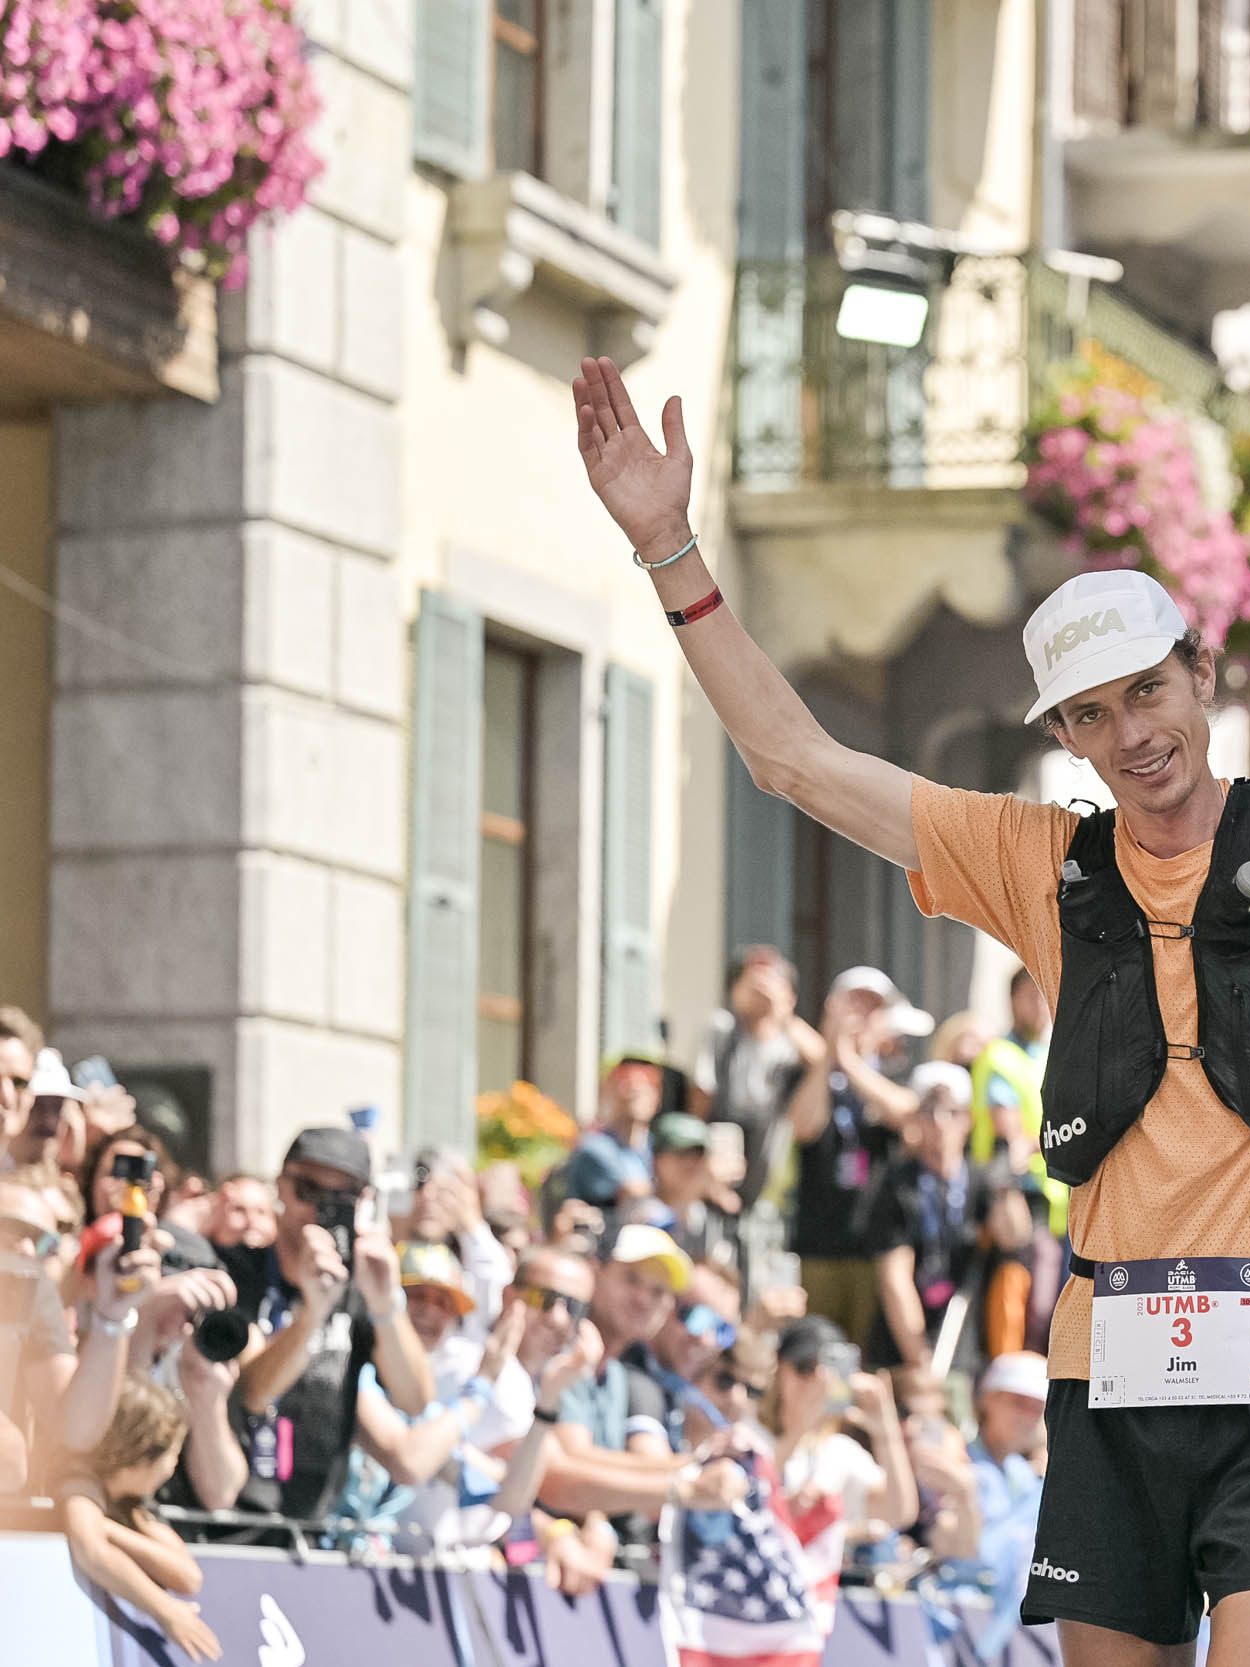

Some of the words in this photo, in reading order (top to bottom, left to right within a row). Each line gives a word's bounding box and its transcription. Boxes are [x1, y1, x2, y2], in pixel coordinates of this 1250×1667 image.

[1043, 607, 1126, 671] HOKA
[1167, 1275, 1196, 1285] UTMB
[1136, 1296, 1144, 1317] 2023
[1170, 1317, 1193, 1348] 3
[1166, 1356, 1197, 1372] Jim
[1164, 1377, 1200, 1385] WALMSLEY
